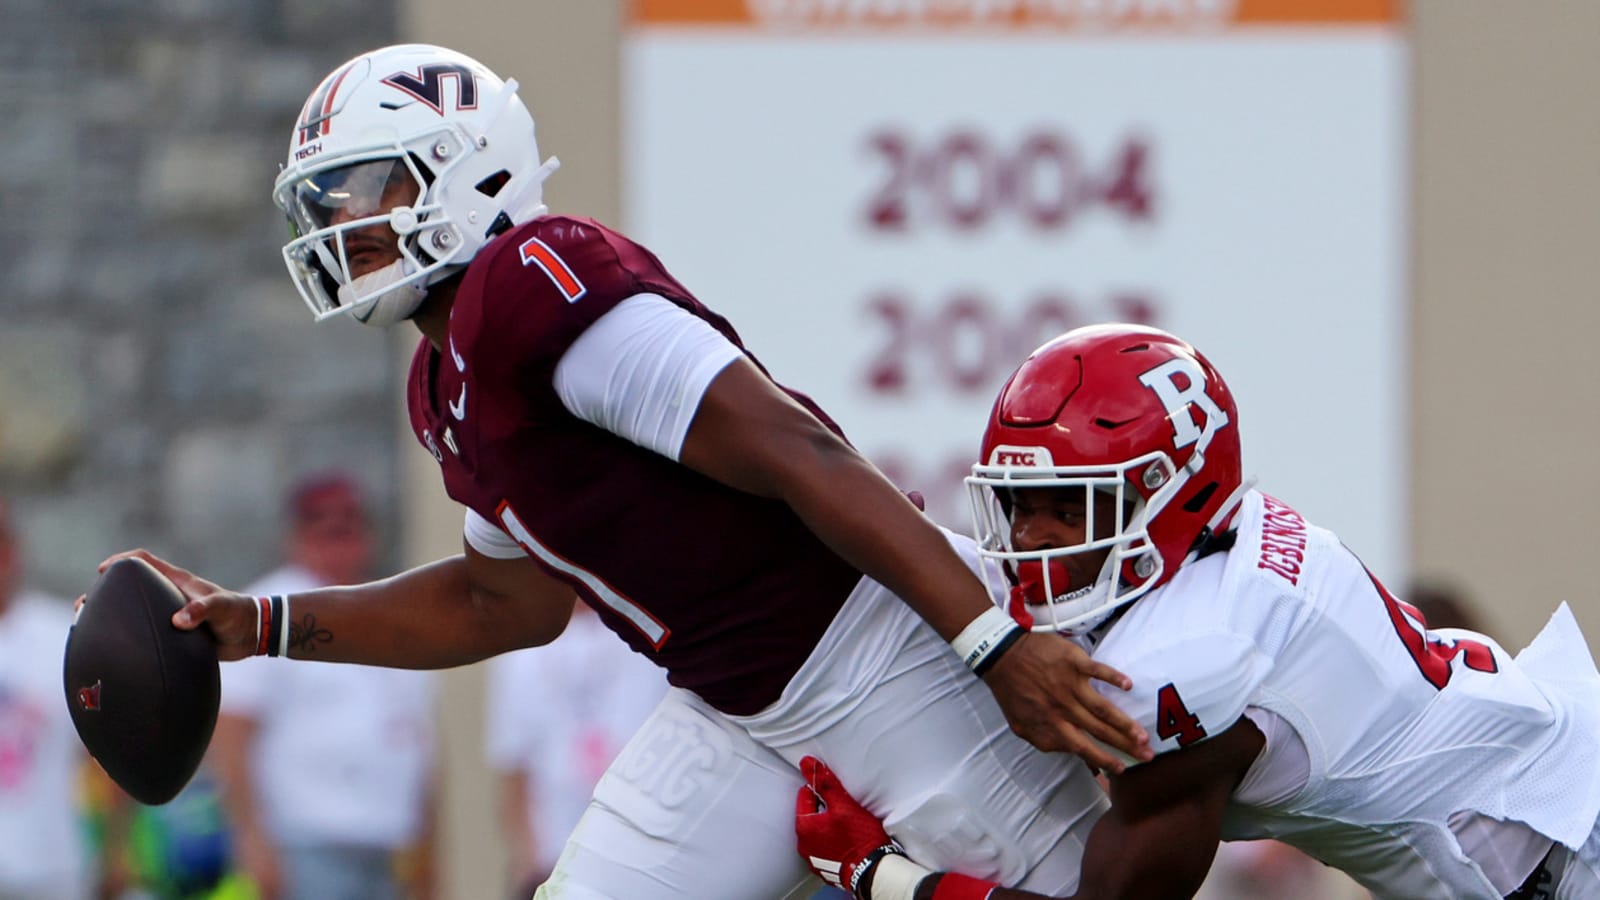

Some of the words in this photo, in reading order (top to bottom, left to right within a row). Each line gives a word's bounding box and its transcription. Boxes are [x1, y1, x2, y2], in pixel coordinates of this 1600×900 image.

[294, 143, 323, 161] TECH
[860, 130, 1158, 230] 2004
[518, 236, 587, 304] 1
[1137, 357, 1230, 450] R
[495, 499, 671, 653] 1
[1156, 681, 1209, 748] 4
